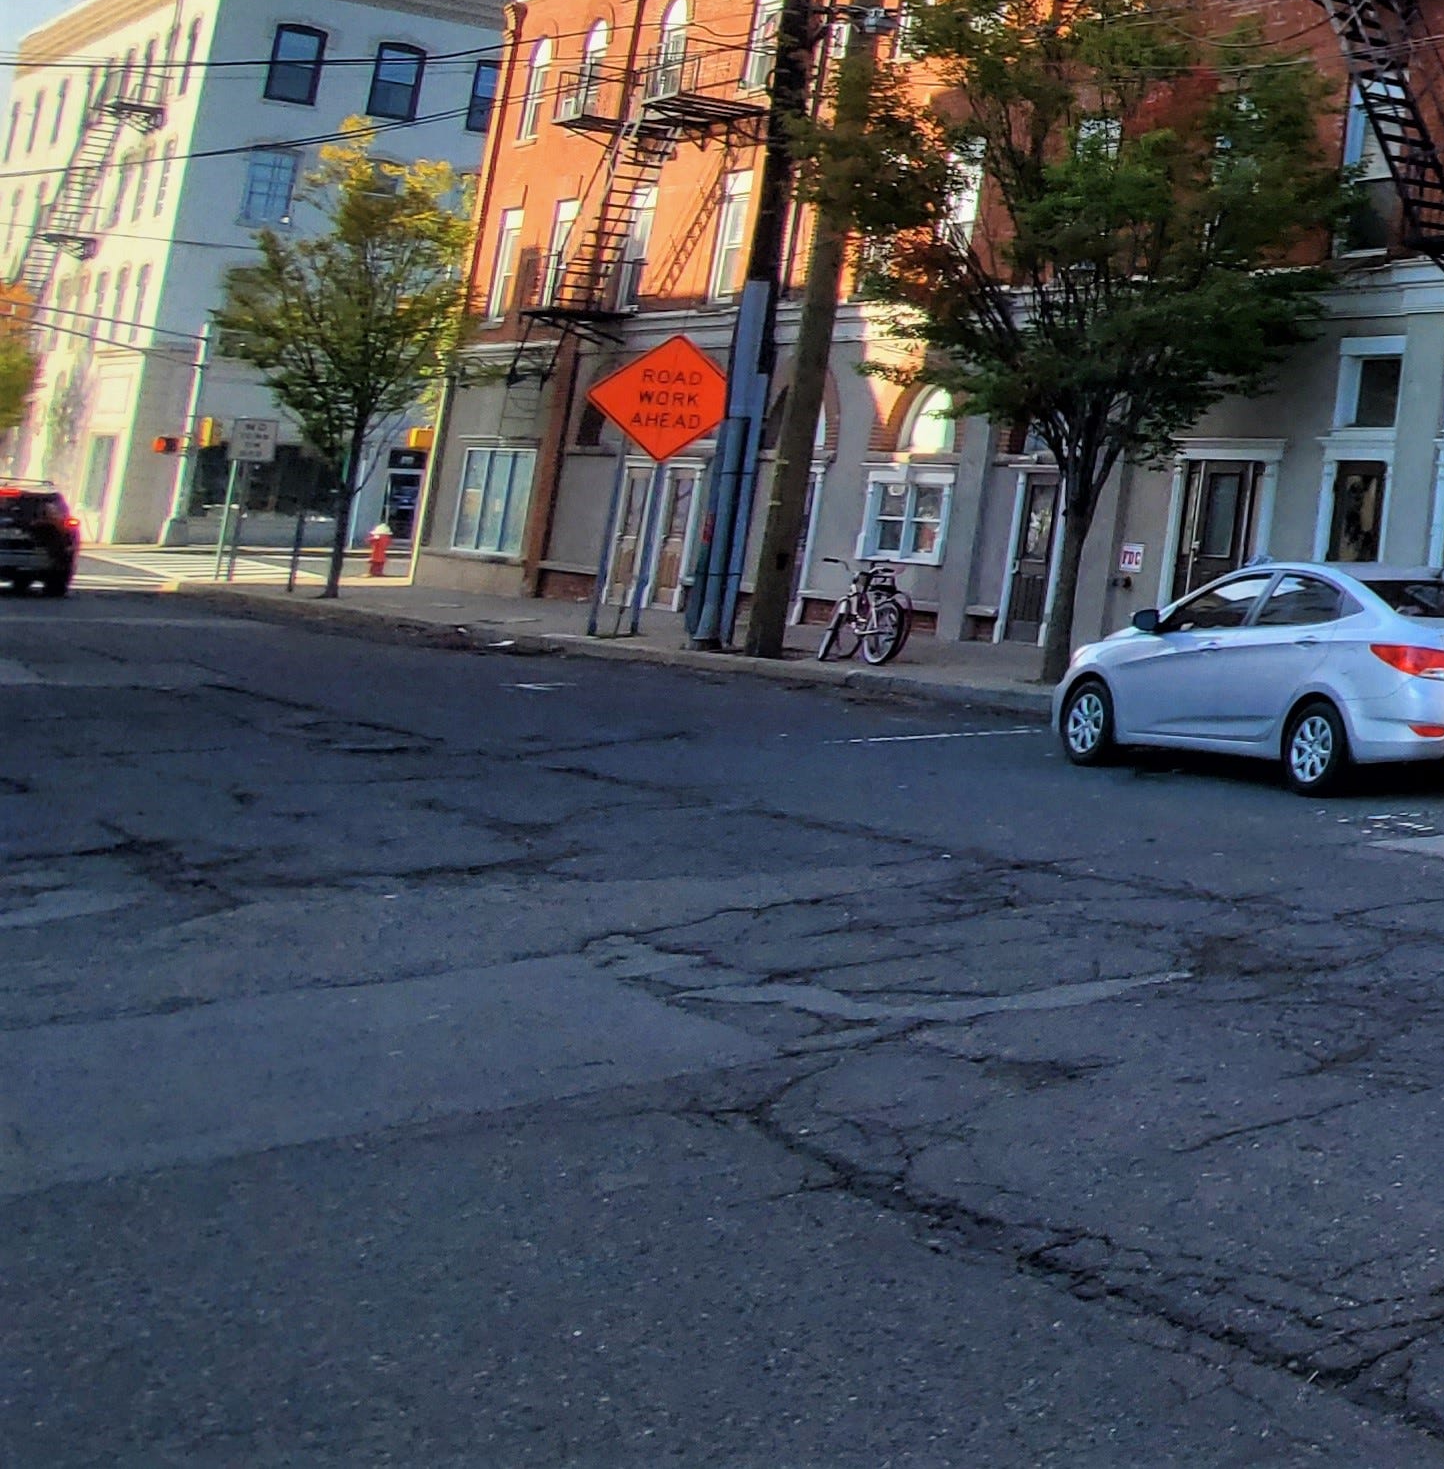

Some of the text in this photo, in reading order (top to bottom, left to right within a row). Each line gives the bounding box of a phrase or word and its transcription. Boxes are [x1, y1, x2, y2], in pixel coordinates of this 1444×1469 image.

[642, 369, 703, 385] ROAD
[639, 391, 699, 407] WORK
[630, 412, 701, 429] AHEAD
[1122, 550, 1142, 565] FDC
